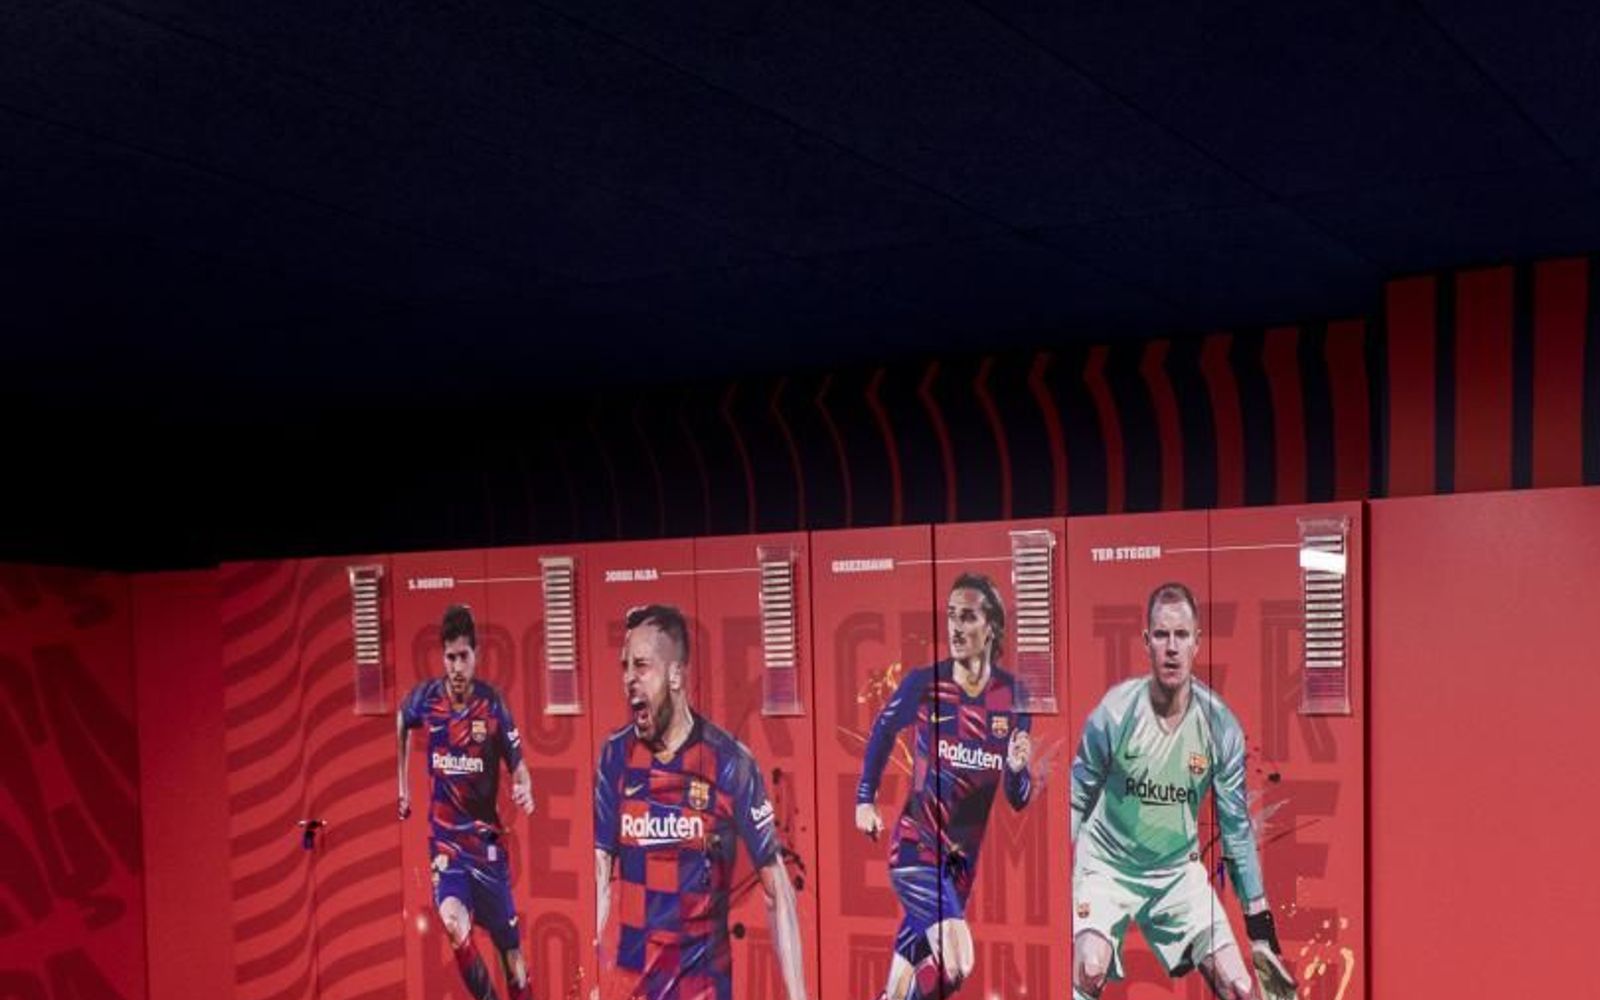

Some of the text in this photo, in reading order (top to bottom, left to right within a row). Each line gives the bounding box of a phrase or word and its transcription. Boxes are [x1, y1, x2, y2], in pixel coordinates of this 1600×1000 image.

[1091, 545, 1161, 562] TER STEGEN
[634, 568, 659, 581] ALBA
[432, 752, 484, 773] Rakuten
[938, 739, 1003, 771] Rakuten
[1126, 777, 1199, 804] Rakuten
[621, 811, 704, 841] Rakuten
